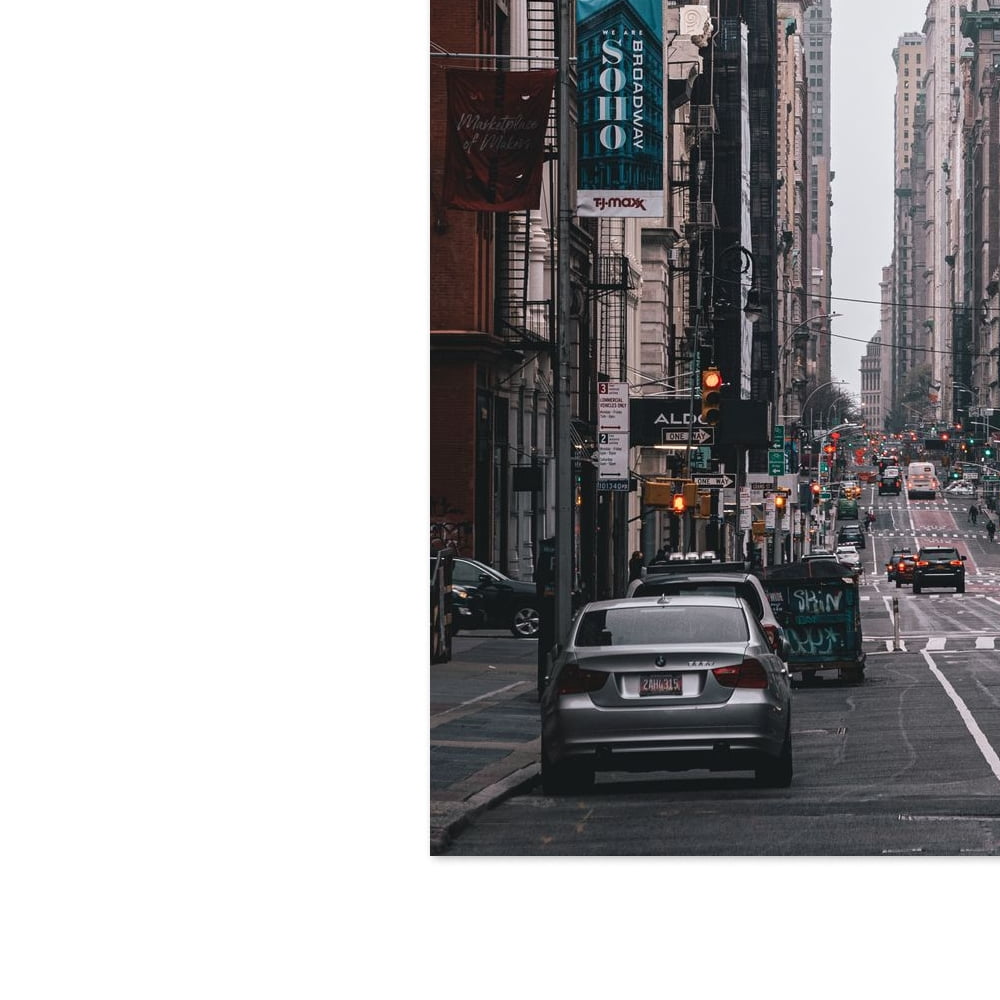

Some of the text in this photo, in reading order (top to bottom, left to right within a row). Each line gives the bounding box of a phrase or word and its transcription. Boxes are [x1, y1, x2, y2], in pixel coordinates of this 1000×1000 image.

[633, 40, 643, 149] BROADWAY
[463, 132, 480, 154] of
[600, 384, 606, 393] 3
[601, 434, 606, 443] 2
